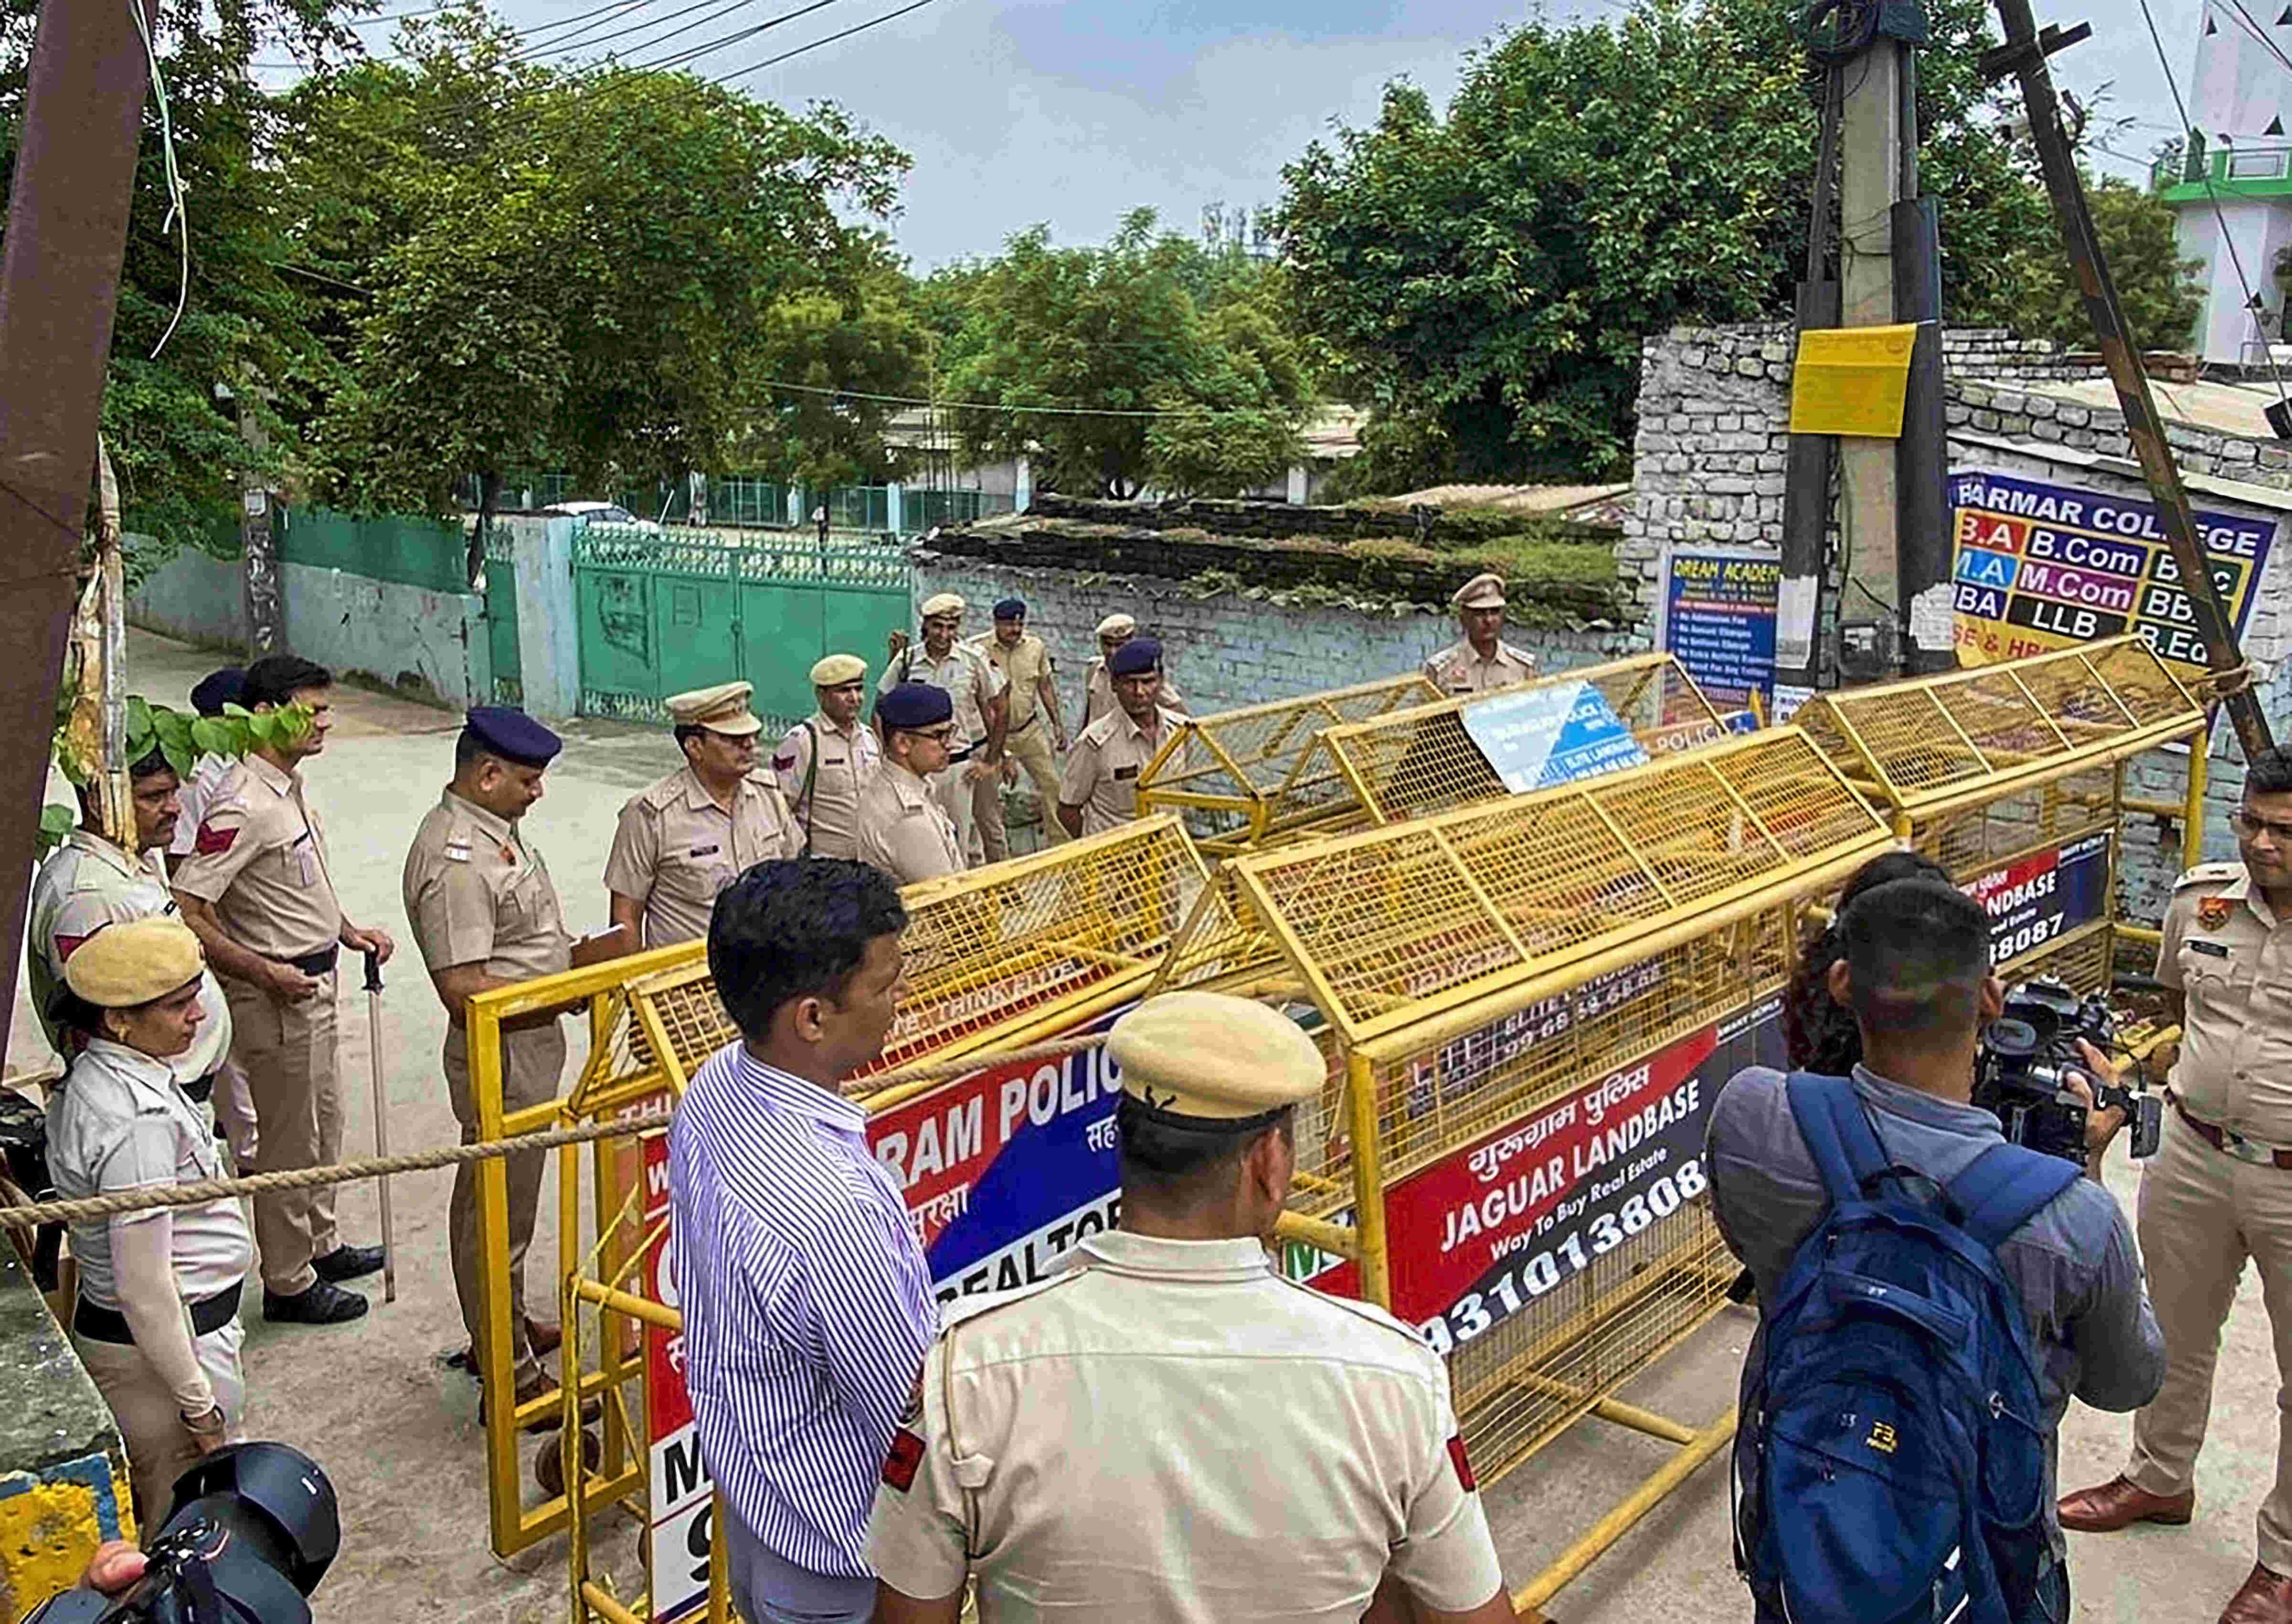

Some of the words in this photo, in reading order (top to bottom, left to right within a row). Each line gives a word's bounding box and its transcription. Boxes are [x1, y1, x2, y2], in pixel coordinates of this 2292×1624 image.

[2030, 529, 2140, 573] B.Com
[2092, 508, 2260, 556] COLGE
[1674, 559, 1719, 578] DREAM
[1724, 562, 1781, 582] ACADEM
[2019, 563, 2132, 610] M.Com
[1952, 585, 1998, 617] BA
[2032, 602, 2098, 638] LLB
[2146, 589, 2196, 623] BB
[1657, 724, 1720, 750] POLIC
[1000, 1047, 1124, 1143] POLIC
[1584, 1062, 1652, 1125] पुलिस
[1441, 1161, 1565, 1252] JAGUAR
[1574, 1079, 1700, 1178] LANDBASE
[1491, 1232, 1530, 1262] Way
[1537, 1213, 1554, 1234] To
[1557, 1193, 1587, 1224] Buy
[1591, 1172, 1625, 1206] Real
[1627, 1147, 1667, 1180] Estate
[1420, 1152, 1707, 1355] 931013808
